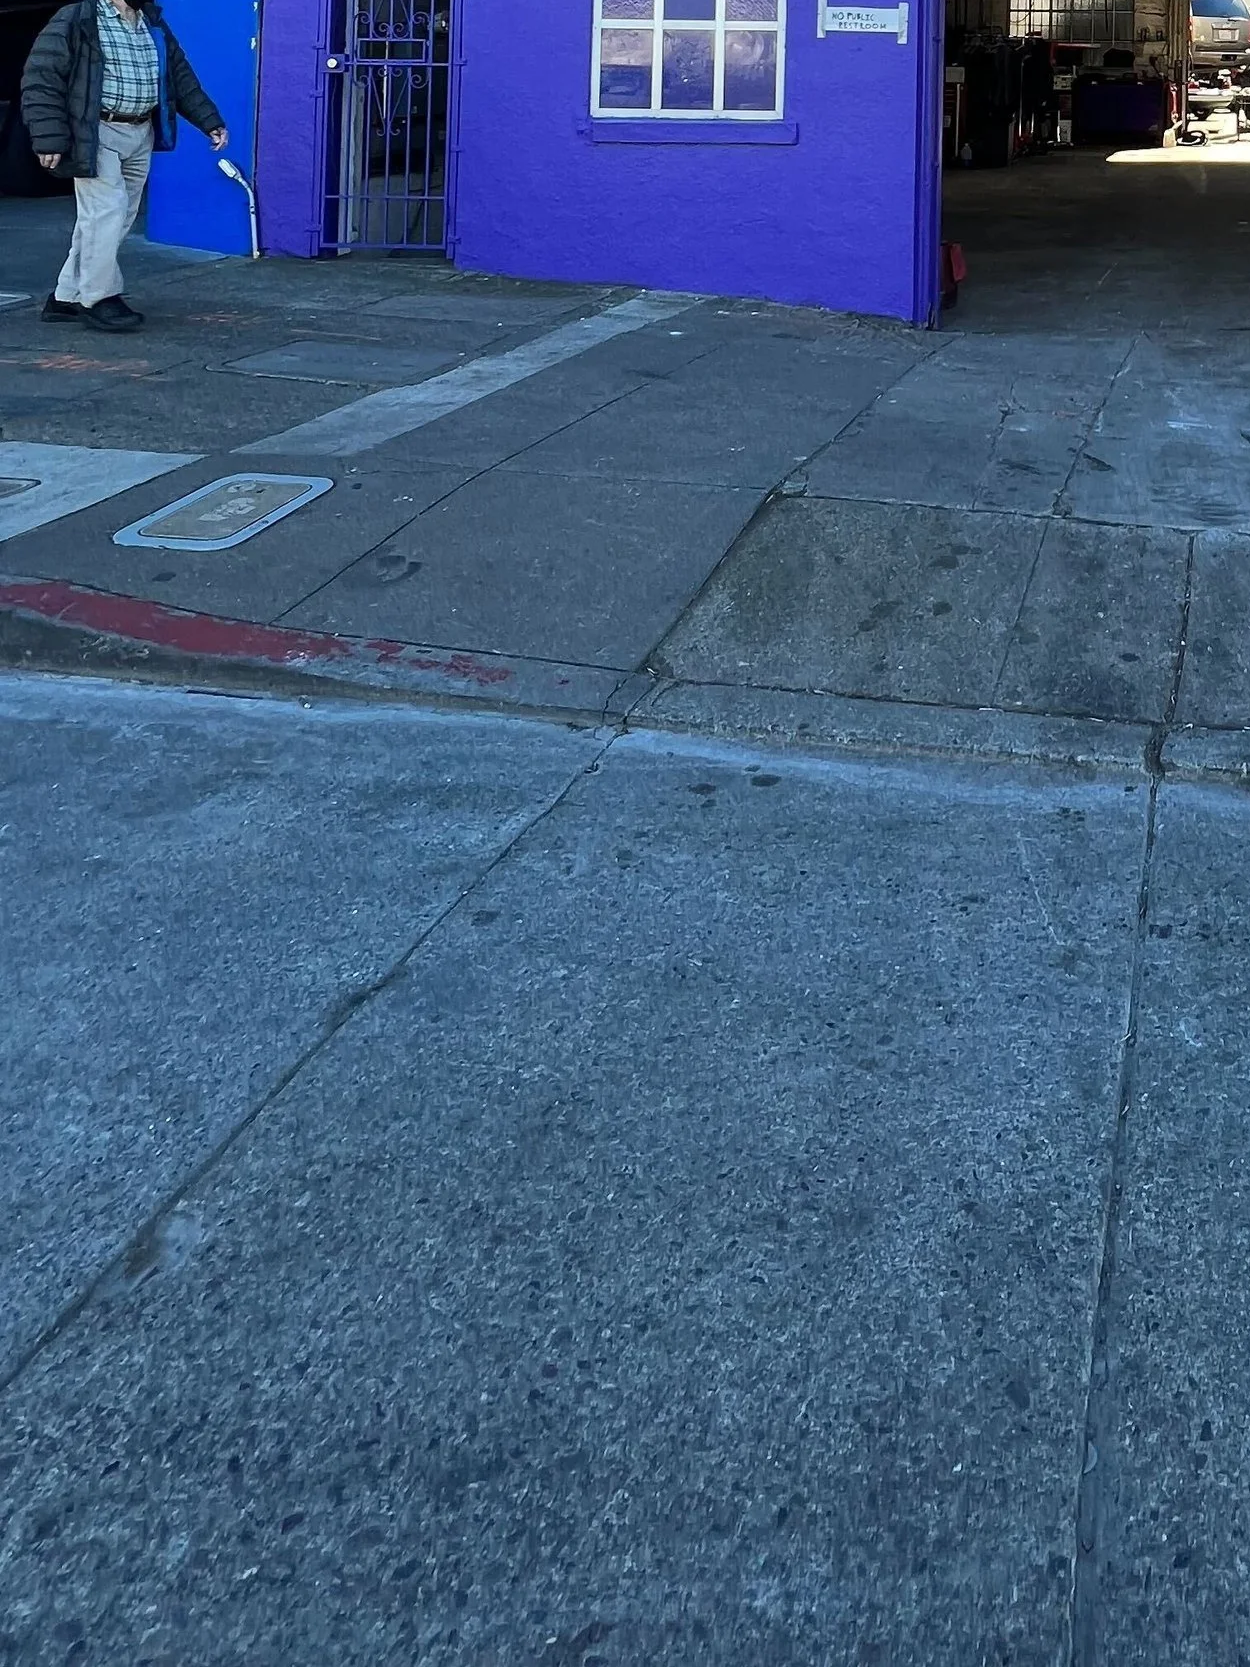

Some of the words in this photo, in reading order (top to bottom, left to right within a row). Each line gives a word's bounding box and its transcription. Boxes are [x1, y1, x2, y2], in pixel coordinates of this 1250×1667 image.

[832, 12, 844, 20] NO
[847, 12, 874, 21] PUBLIC
[838, 21, 887, 29] RESTROOM
